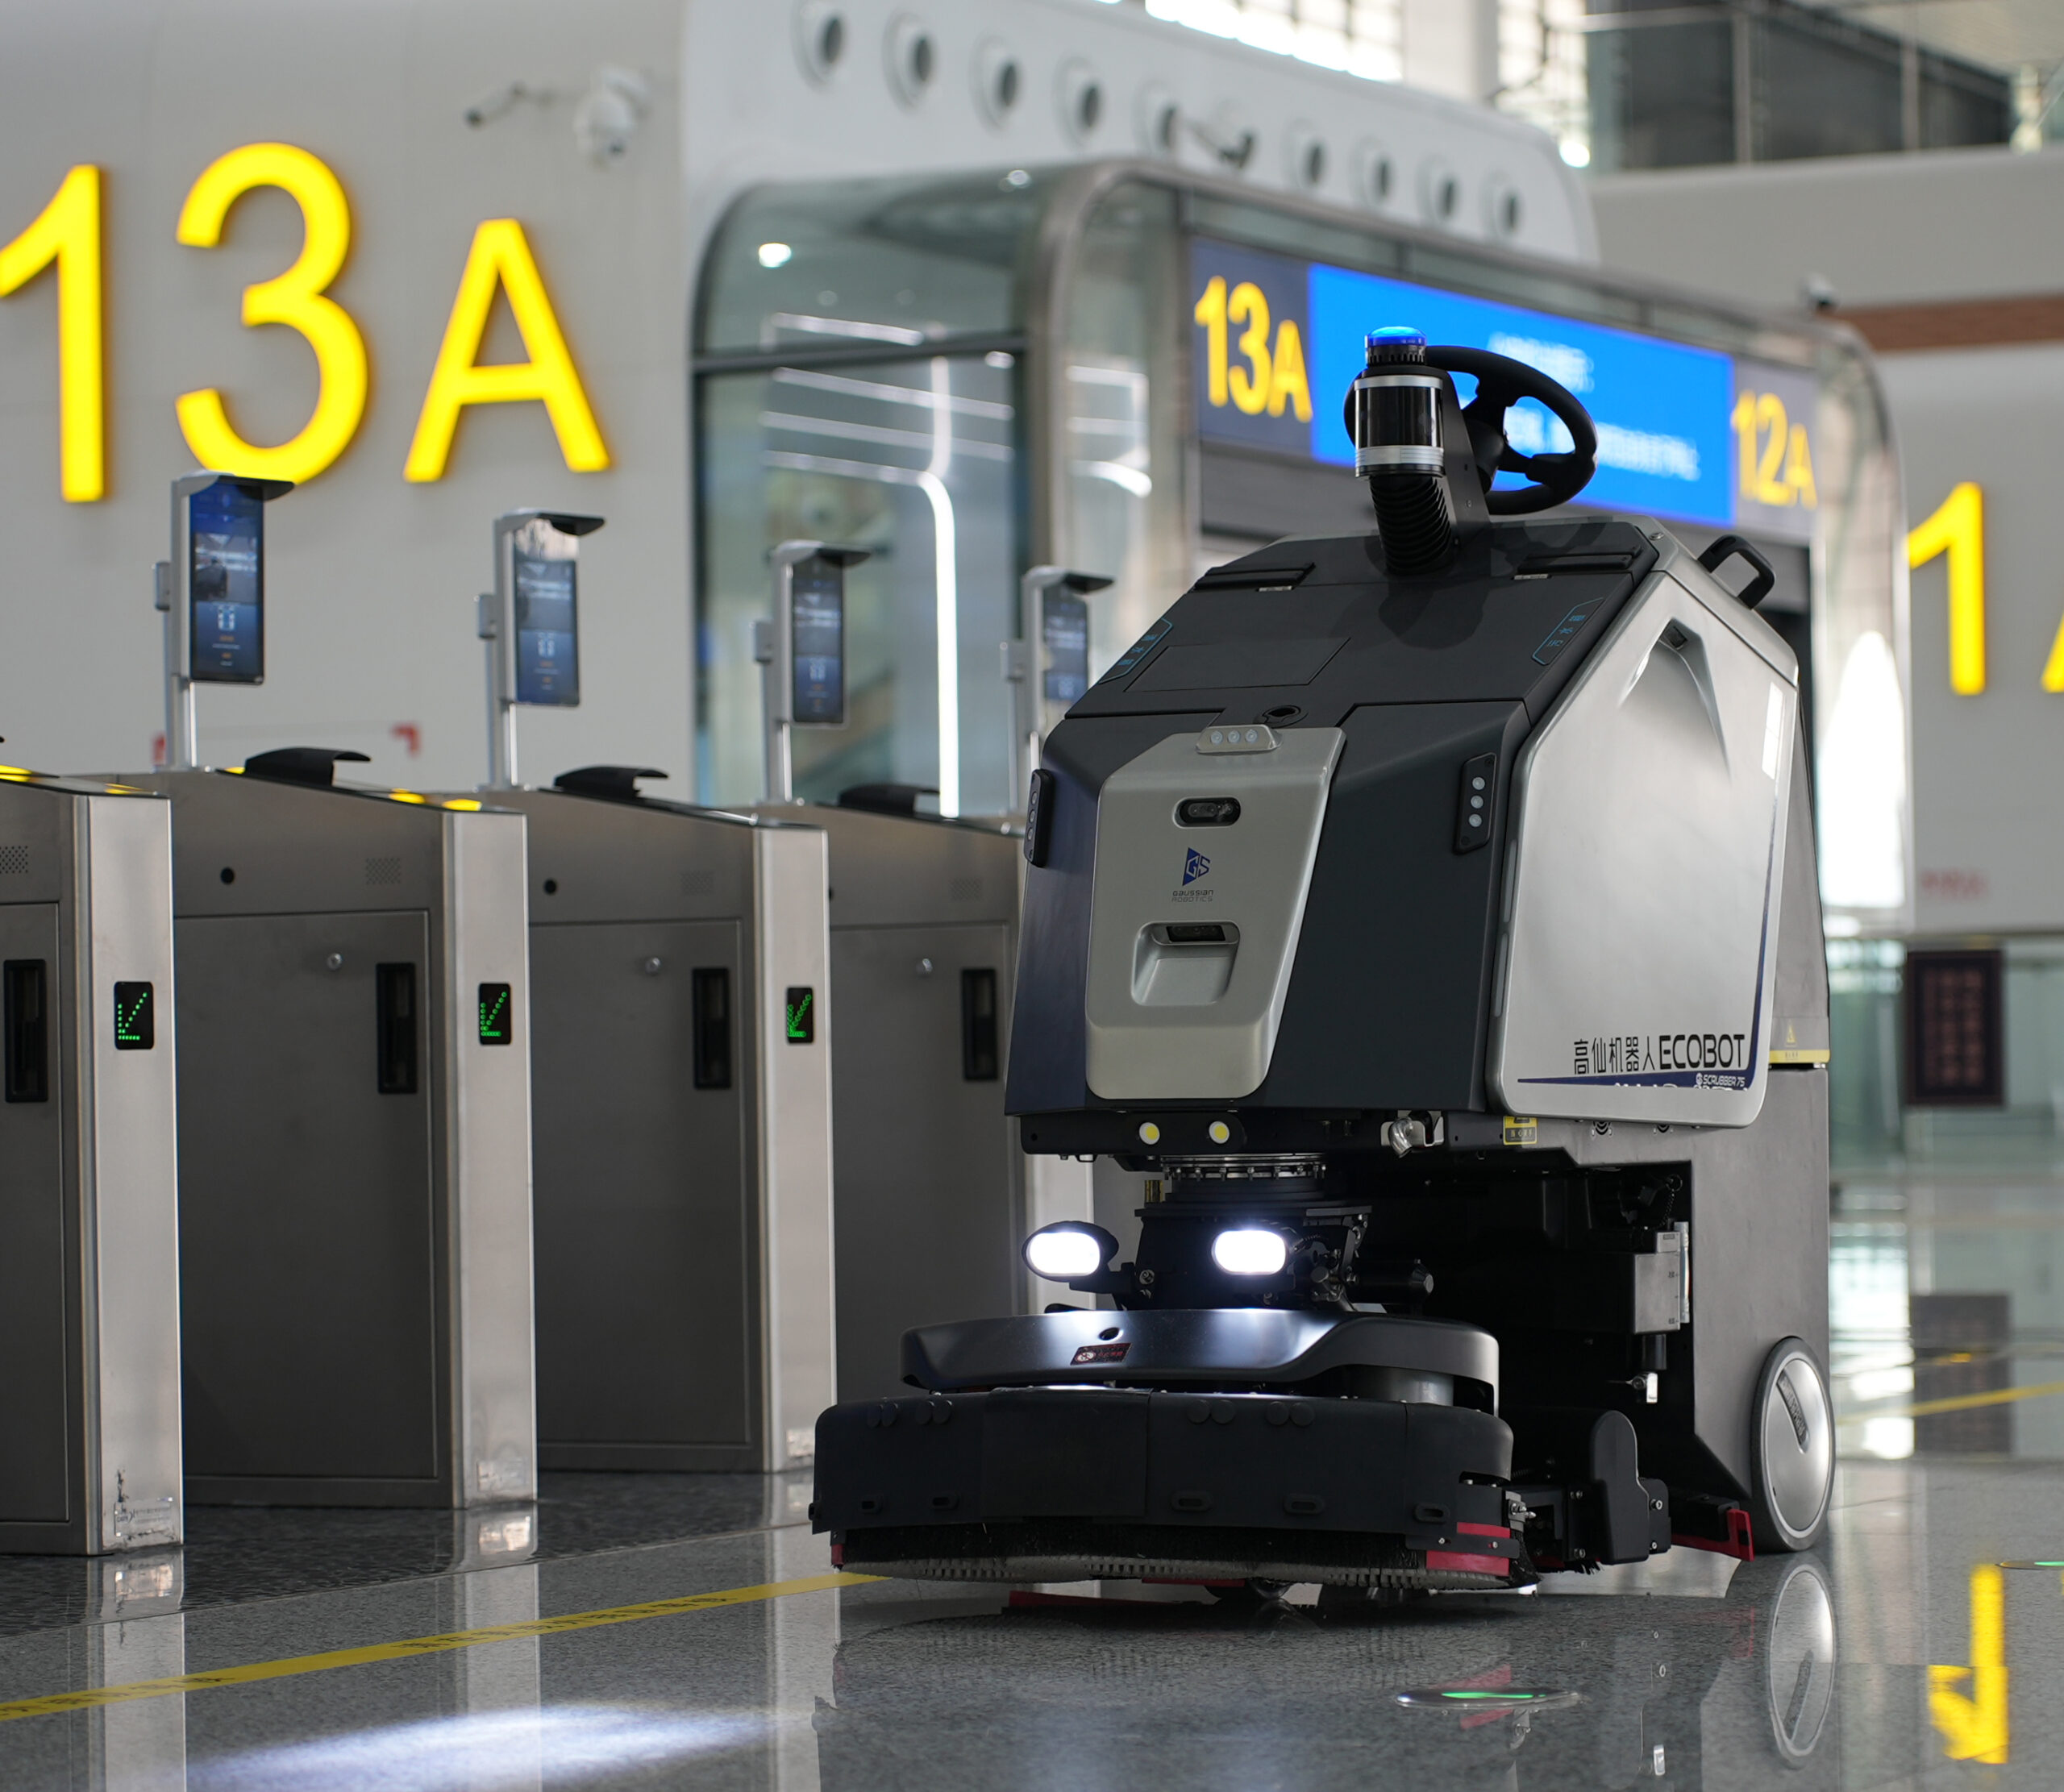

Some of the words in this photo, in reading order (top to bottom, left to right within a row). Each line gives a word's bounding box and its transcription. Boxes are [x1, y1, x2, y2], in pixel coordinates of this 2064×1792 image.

[0, 142, 611, 504] 13A
[1193, 274, 1314, 424] 13A
[1733, 390, 1817, 509] 12A
[1574, 1036, 1655, 1075] 高仙机器人
[1659, 1033, 1745, 1070] ECOBOT
[1703, 1074, 1737, 1087] SCRUBBER
